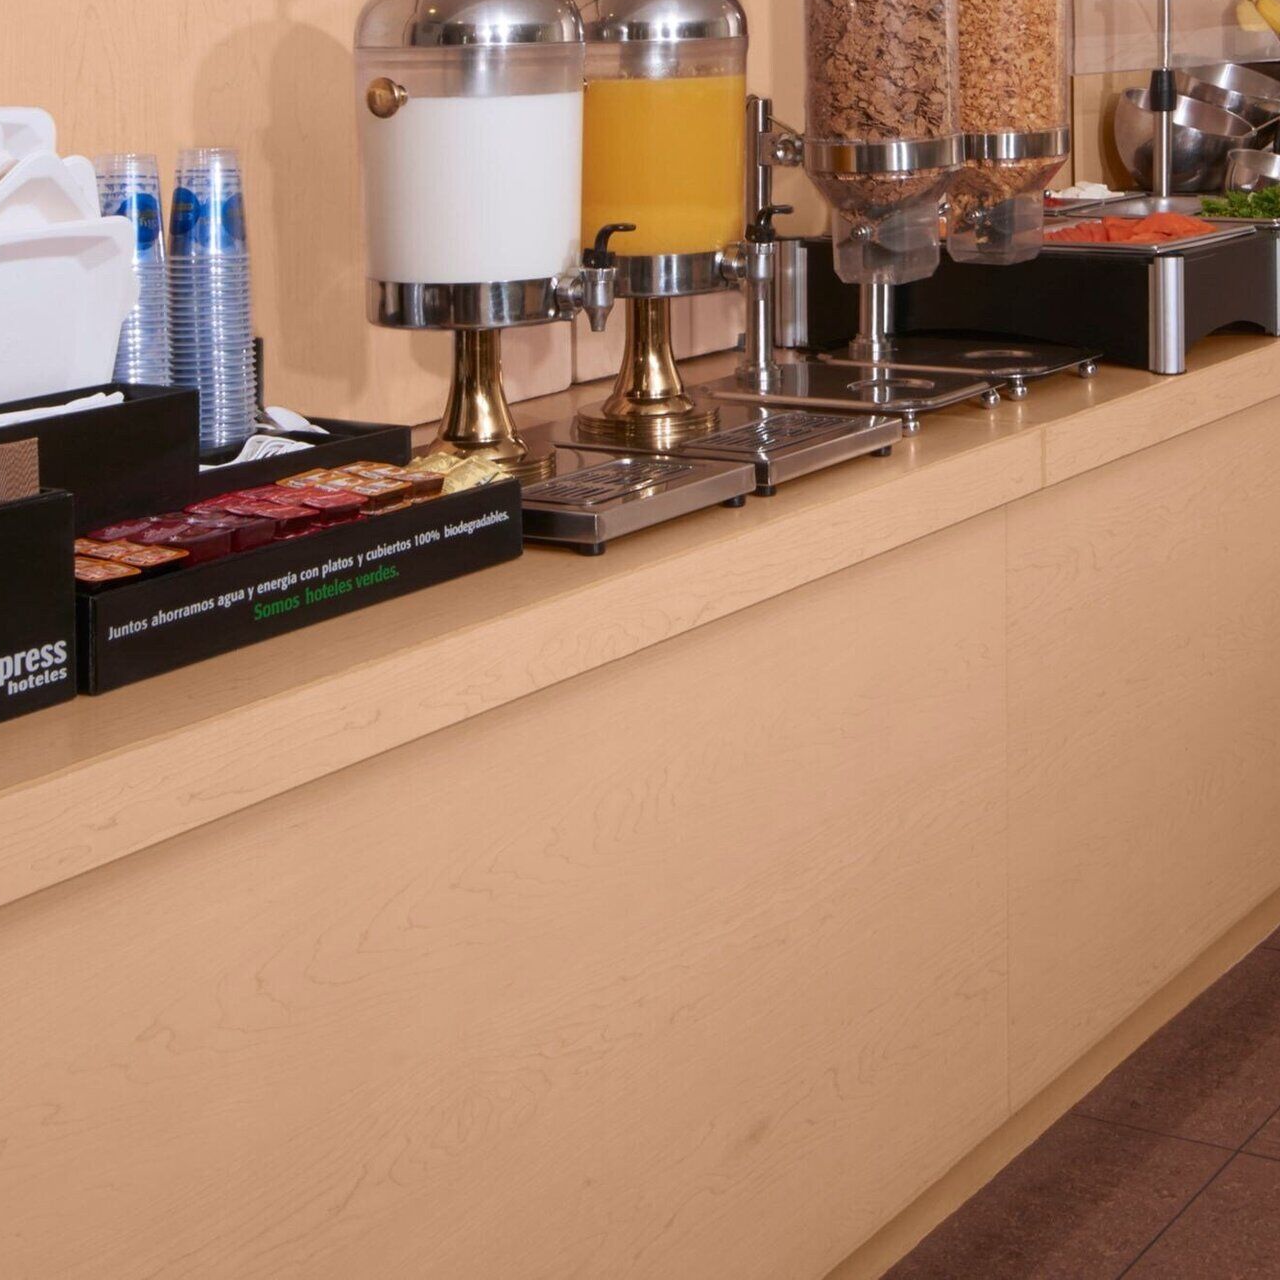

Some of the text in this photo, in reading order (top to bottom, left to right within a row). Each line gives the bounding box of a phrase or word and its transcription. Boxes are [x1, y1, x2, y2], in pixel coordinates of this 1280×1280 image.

[108, 509, 510, 641] Juntos ahorramos agua y energía con platos y cubiertos 100% biodegradables.
[253, 563, 400, 621] Somos hoteles verdes.
[7, 667, 68, 696] hoteles
